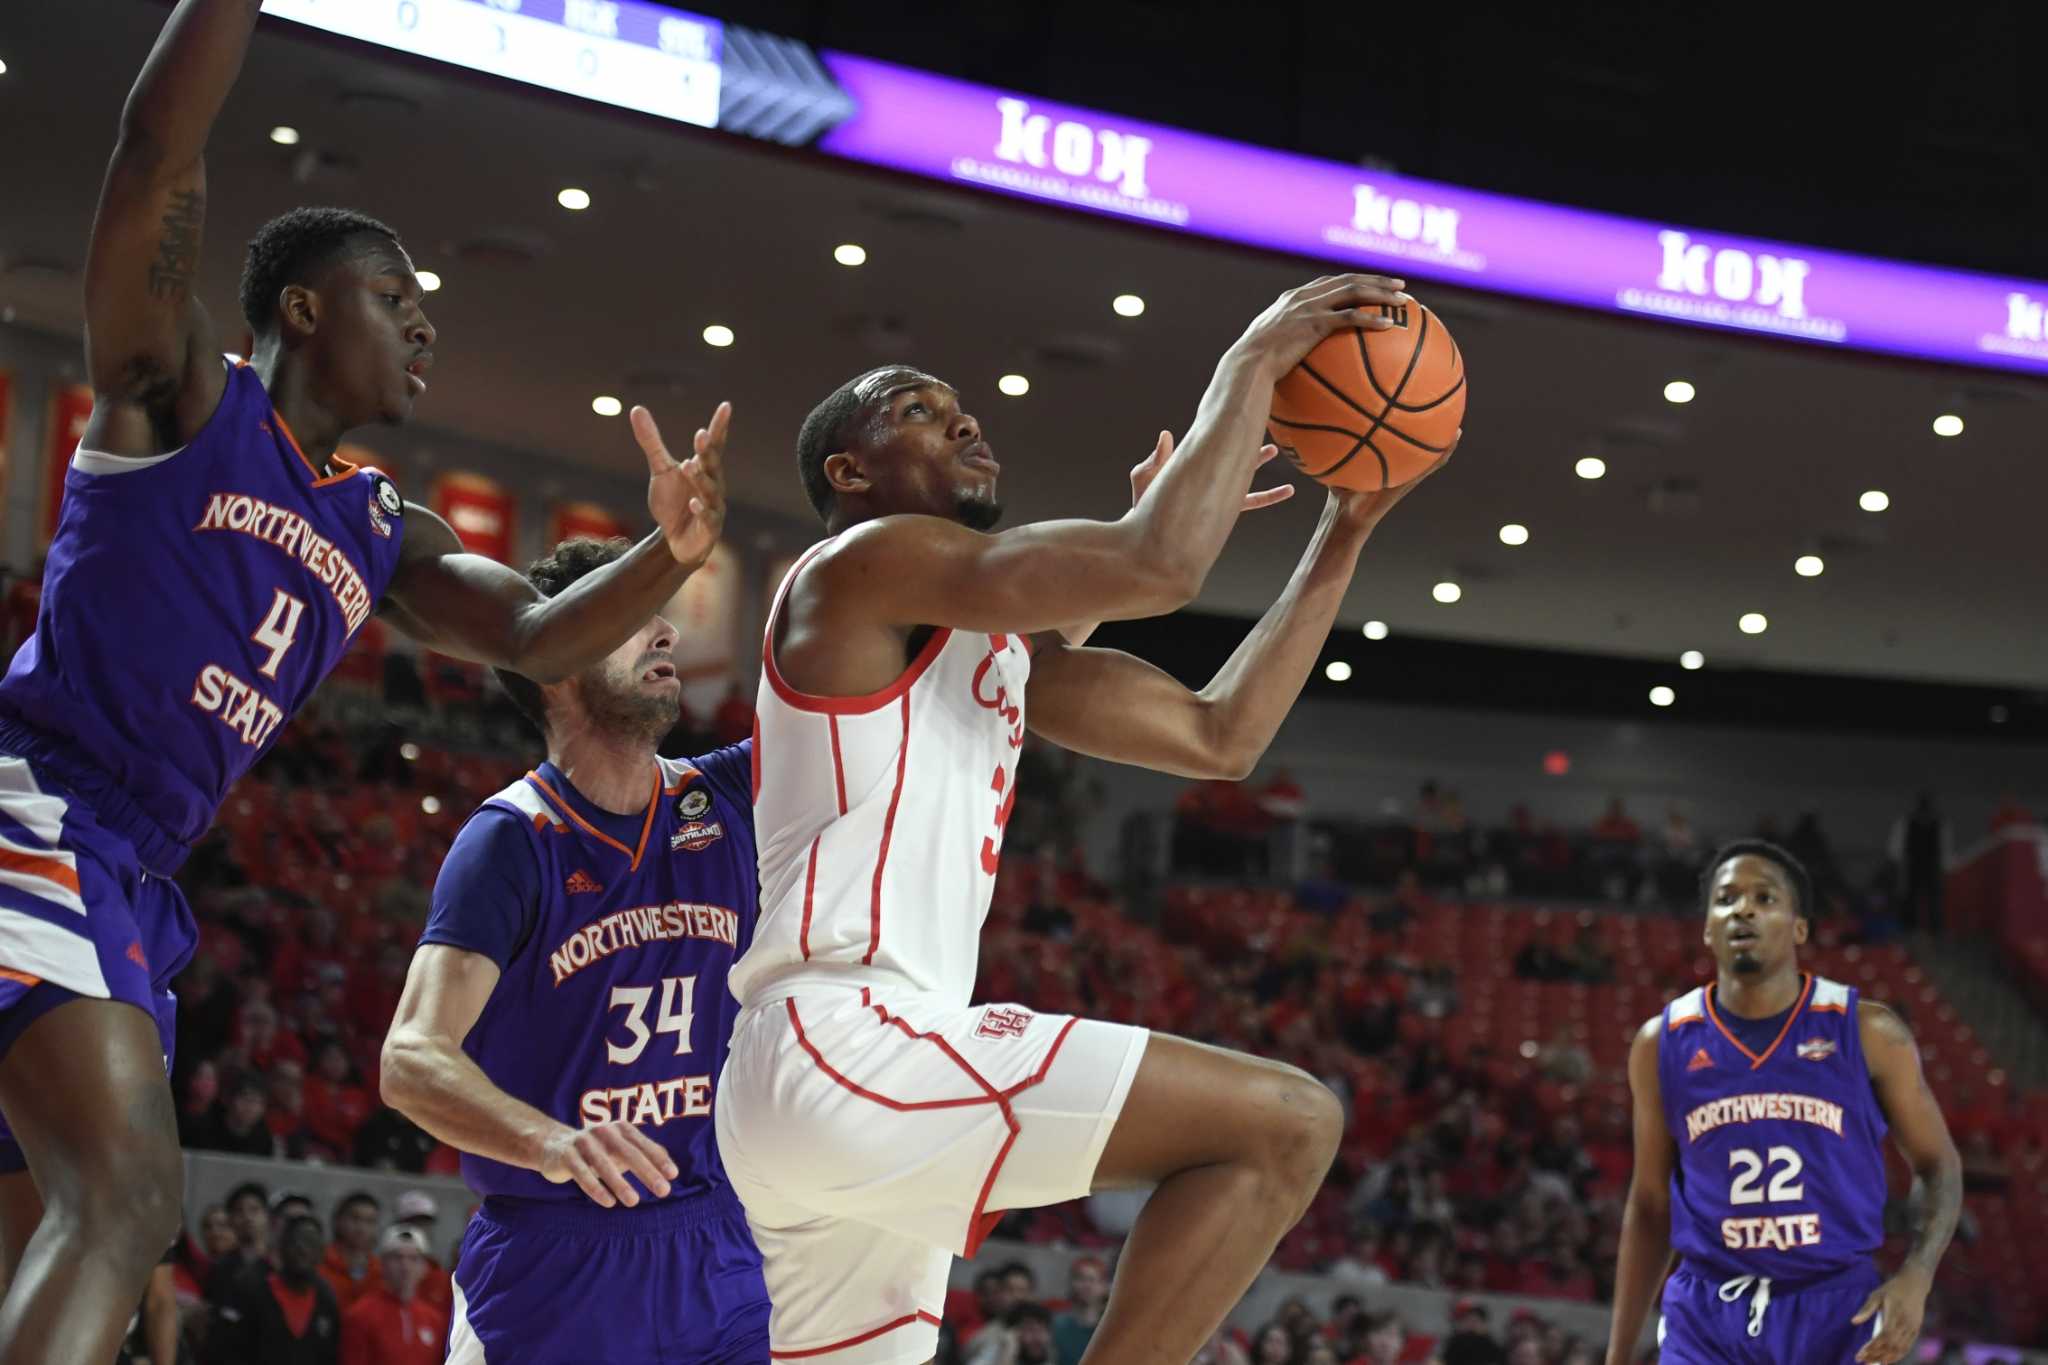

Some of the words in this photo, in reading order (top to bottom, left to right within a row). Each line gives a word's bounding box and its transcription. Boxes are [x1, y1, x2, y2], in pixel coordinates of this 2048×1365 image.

[194, 493, 372, 643] NORTHWESTERN
[252, 588, 305, 680] 4
[551, 903, 739, 987] NORTHWESTERN
[606, 974, 698, 1066] 34
[580, 1074, 712, 1131] STATE
[1685, 1093, 1845, 1144] NORTHWESTERN
[1728, 1144, 1805, 1206] 22
[1720, 1213, 1820, 1251] STATE
